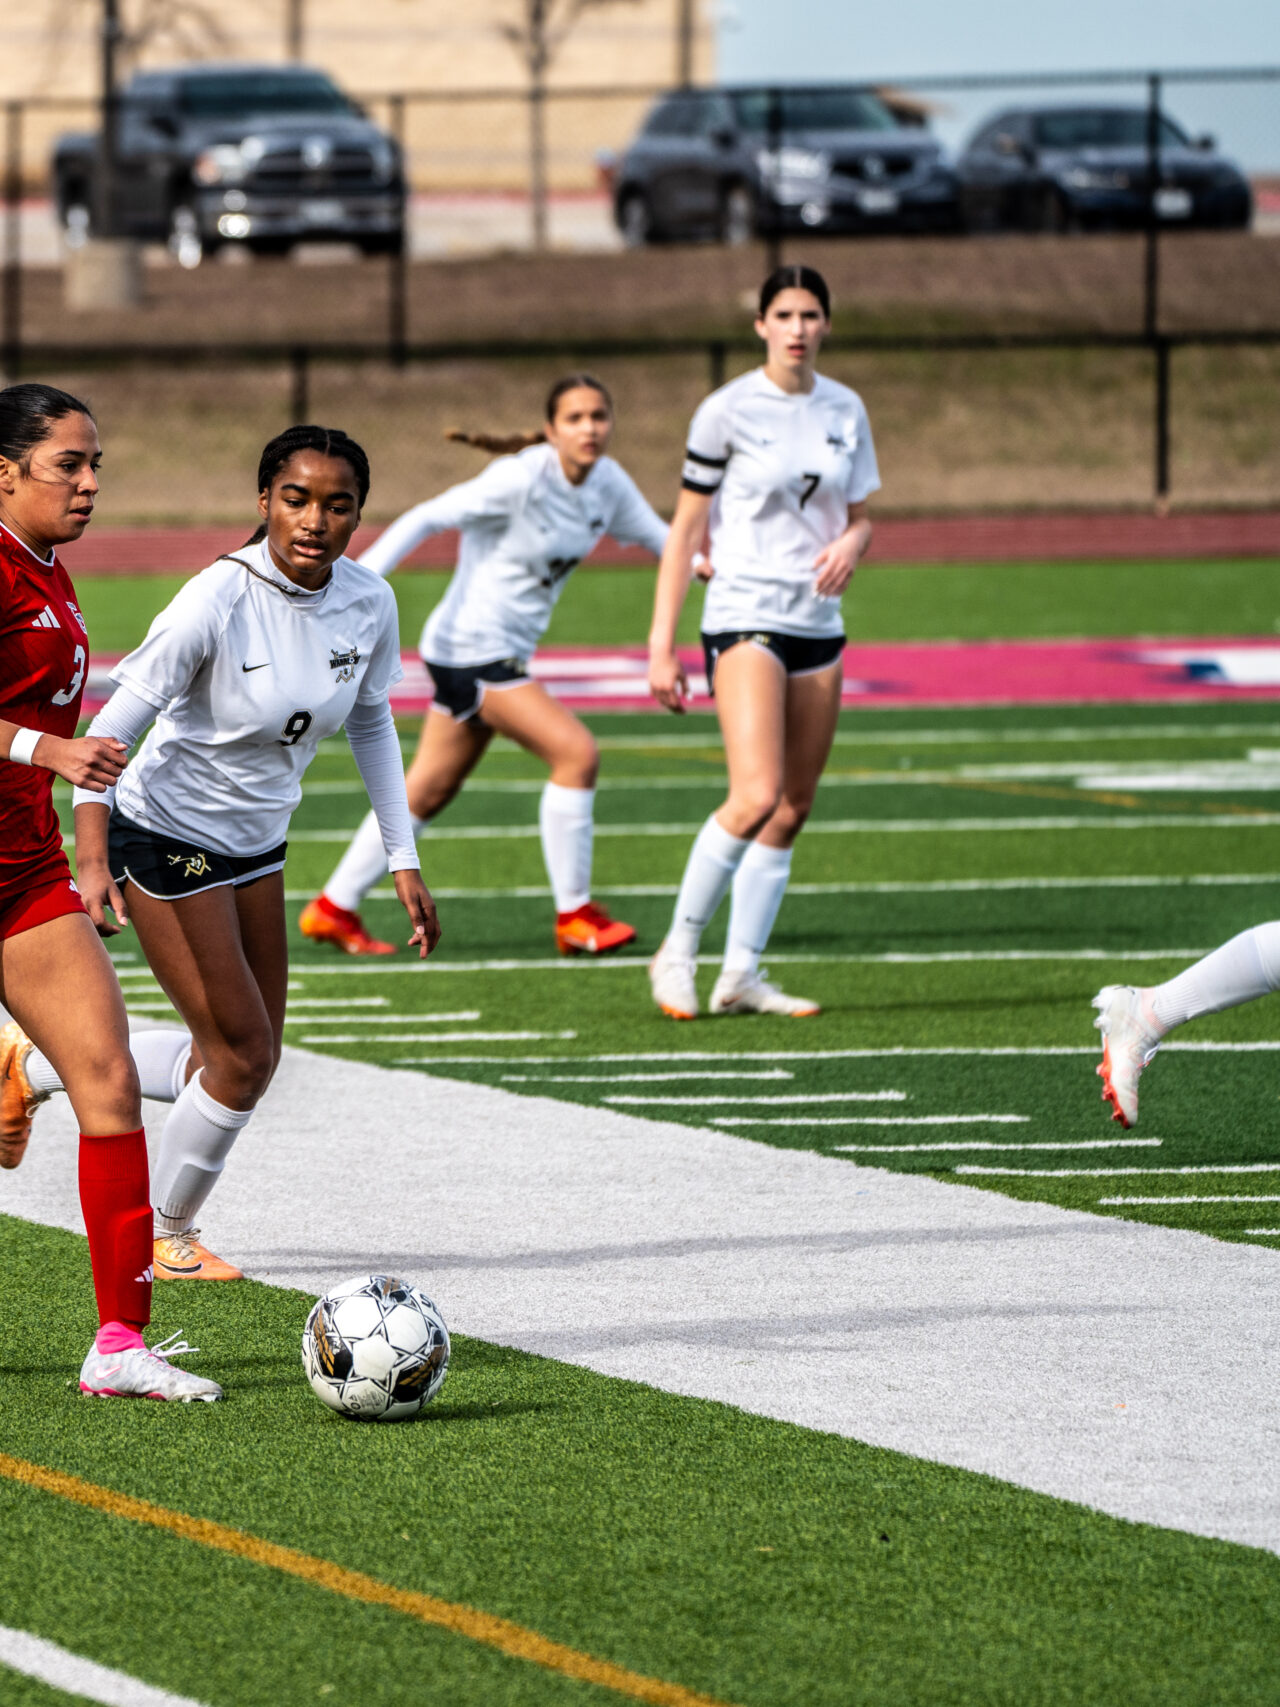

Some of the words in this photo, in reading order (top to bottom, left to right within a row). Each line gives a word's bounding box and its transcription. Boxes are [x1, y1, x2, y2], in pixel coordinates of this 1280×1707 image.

[800, 473, 821, 510] 7
[51, 644, 86, 706] 3
[278, 707, 314, 746] 9
